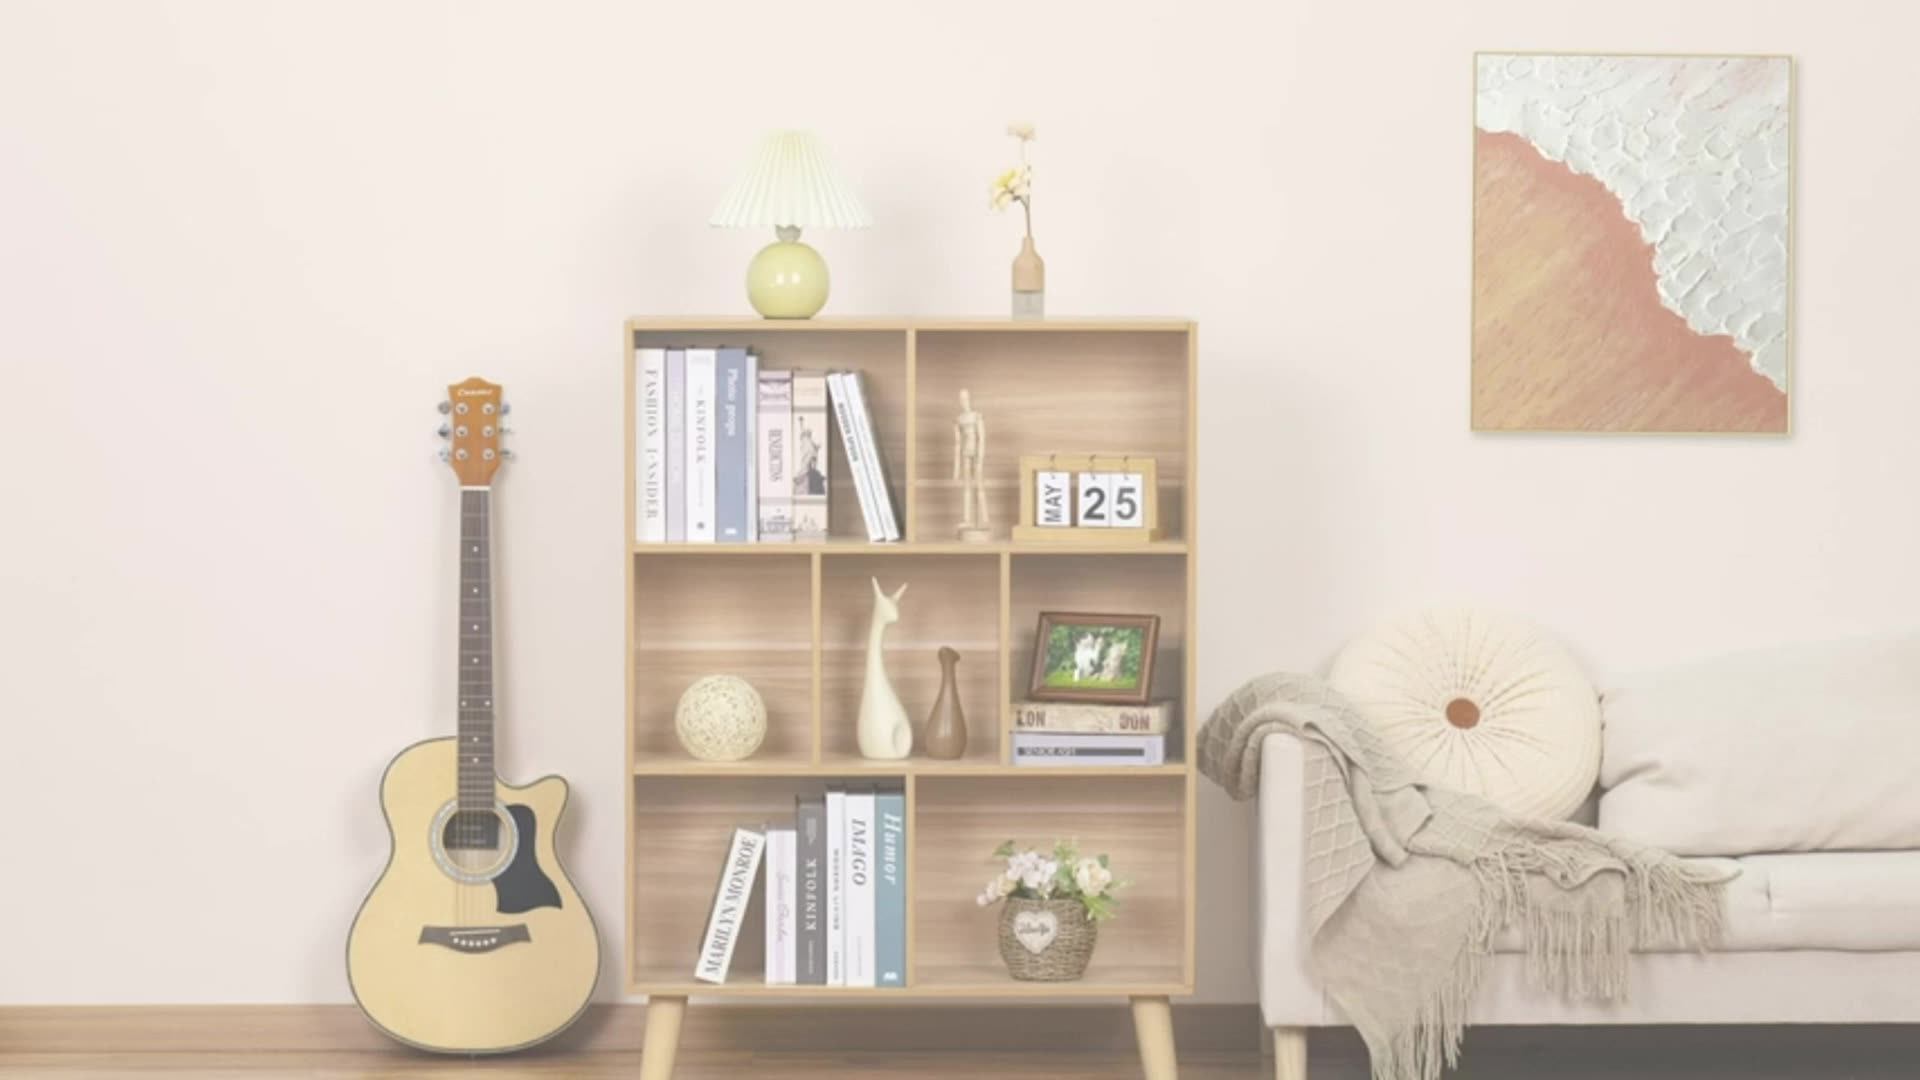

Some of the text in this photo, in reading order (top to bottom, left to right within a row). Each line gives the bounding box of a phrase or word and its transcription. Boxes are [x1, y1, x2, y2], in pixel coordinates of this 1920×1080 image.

[645, 369, 659, 437] FASHION
[696, 400, 706, 463] KINFOLK
[1044, 484, 1062, 522] MAY
[1083, 487, 1137, 521] 25
[1016, 709, 1047, 727] LON
[851, 818, 867, 886] IMAGO
[883, 813, 902, 885] Humor
[704, 837, 758, 975] MARILYN MONROE
[805, 857, 817, 931] KINFOLK
